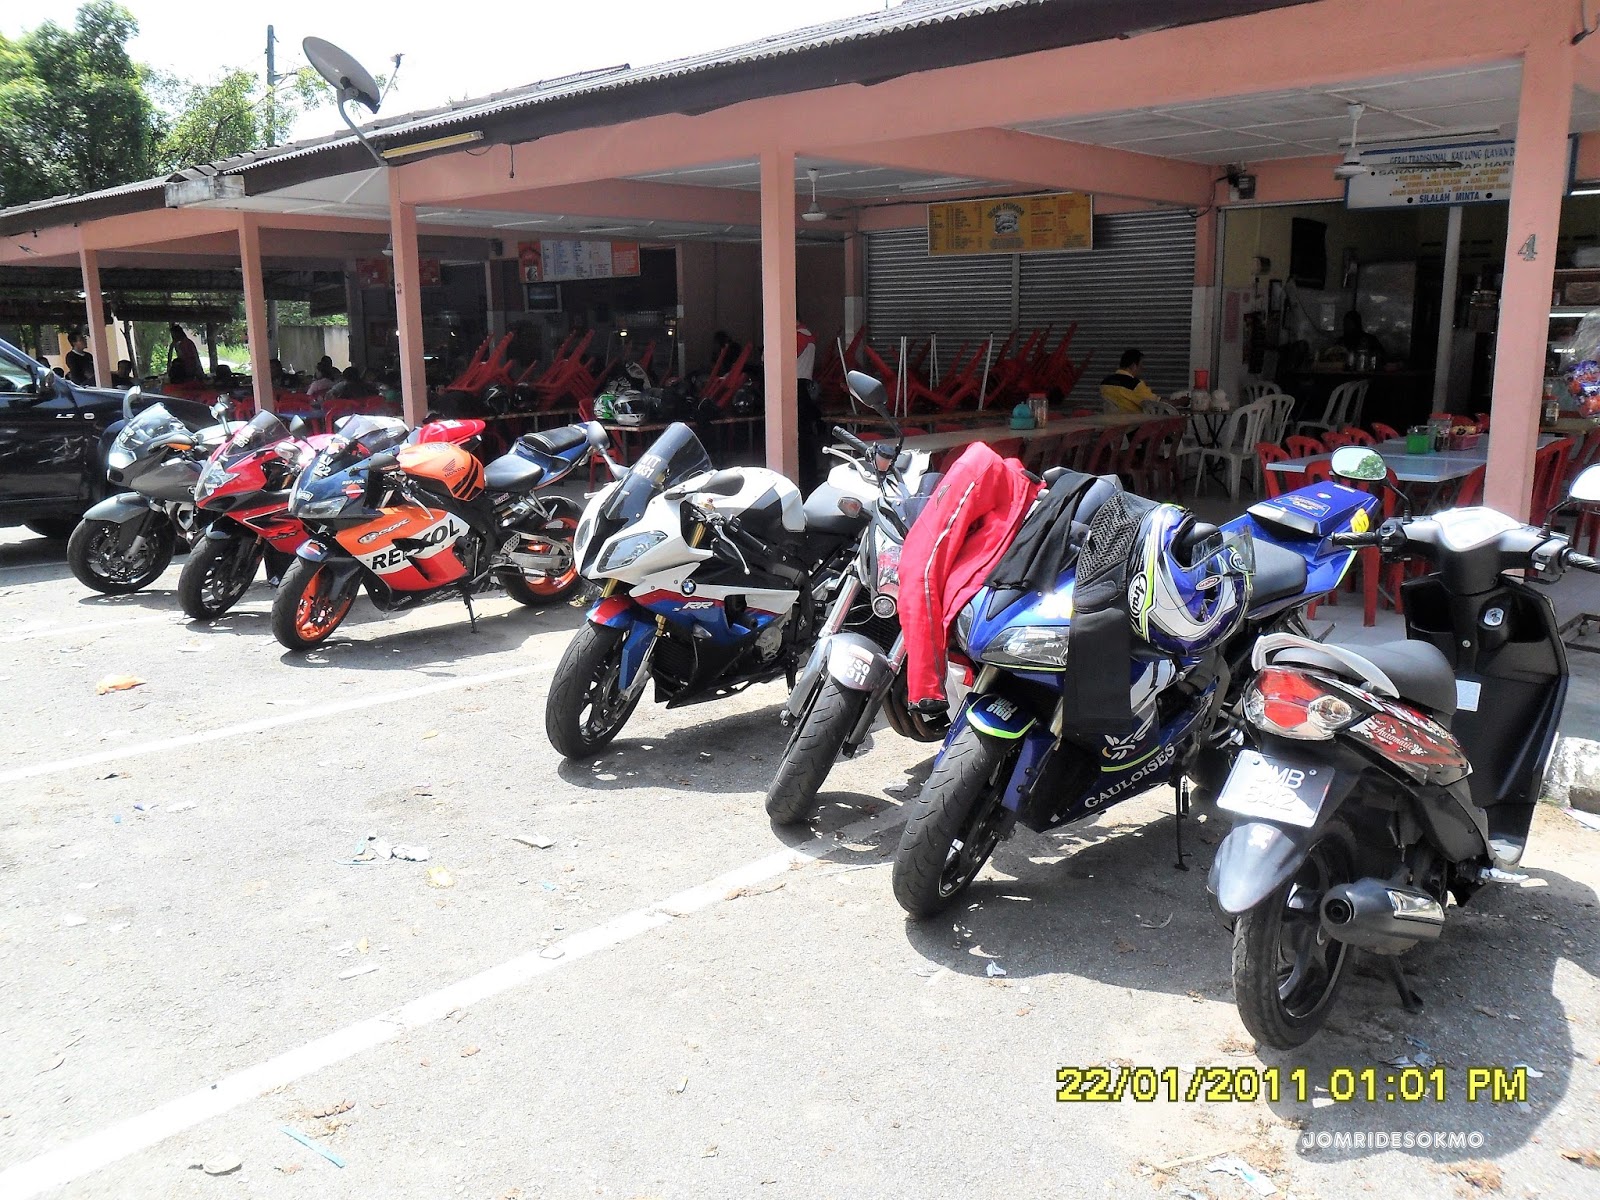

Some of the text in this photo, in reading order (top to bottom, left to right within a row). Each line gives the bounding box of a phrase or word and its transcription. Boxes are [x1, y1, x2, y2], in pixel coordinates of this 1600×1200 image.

[1419, 191, 1480, 203] SILALAH MINTA
[1518, 233, 1538, 261] 4
[444, 466, 466, 478] HONDA
[371, 518, 460, 570] RESOL
[682, 601, 714, 610] RR
[1084, 742, 1176, 808] GAULOISES
